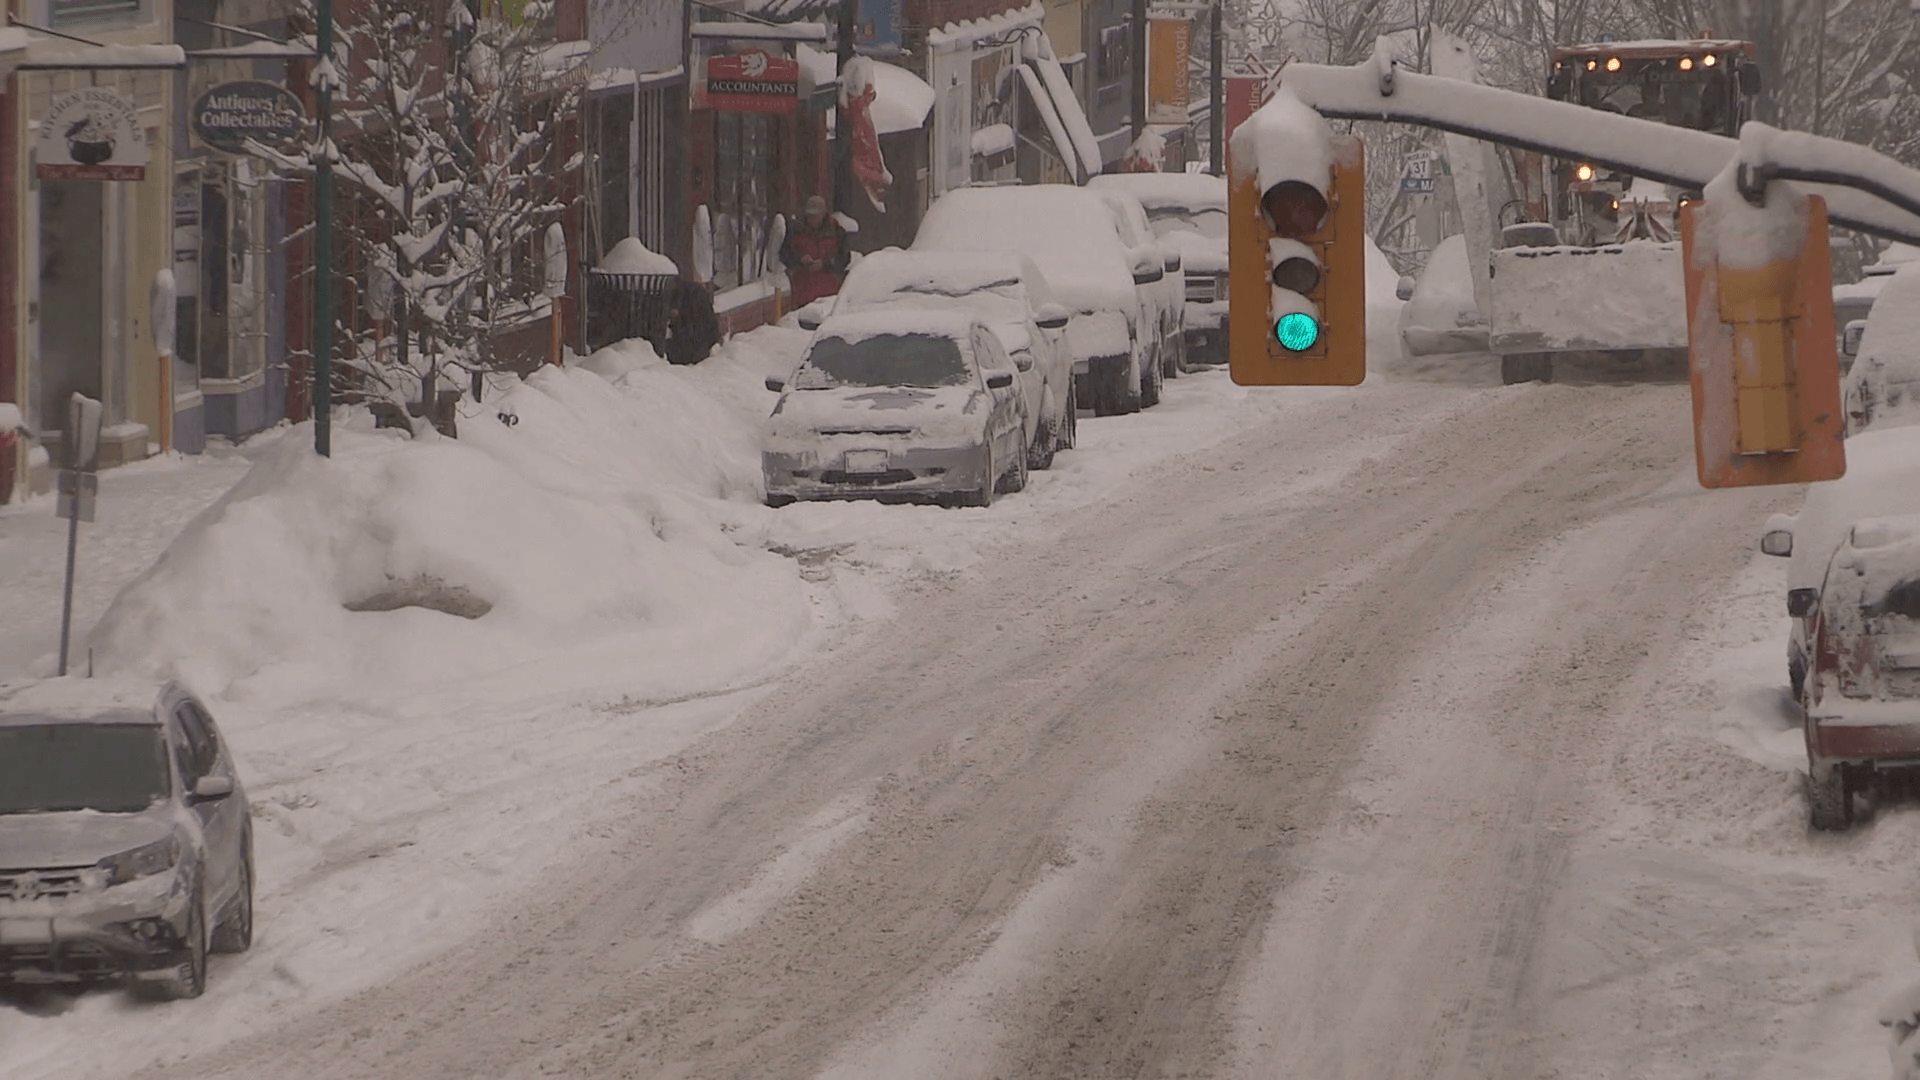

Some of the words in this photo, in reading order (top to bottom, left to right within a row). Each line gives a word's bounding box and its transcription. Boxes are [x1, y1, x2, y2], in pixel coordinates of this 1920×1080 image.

[711, 81, 796, 94] ACCOUNTANTS
[207, 93, 273, 112] Antiques
[40, 92, 81, 140] KITCHEN
[85, 90, 143, 142] ESSENTIALS
[1412, 160, 1427, 174] 37
